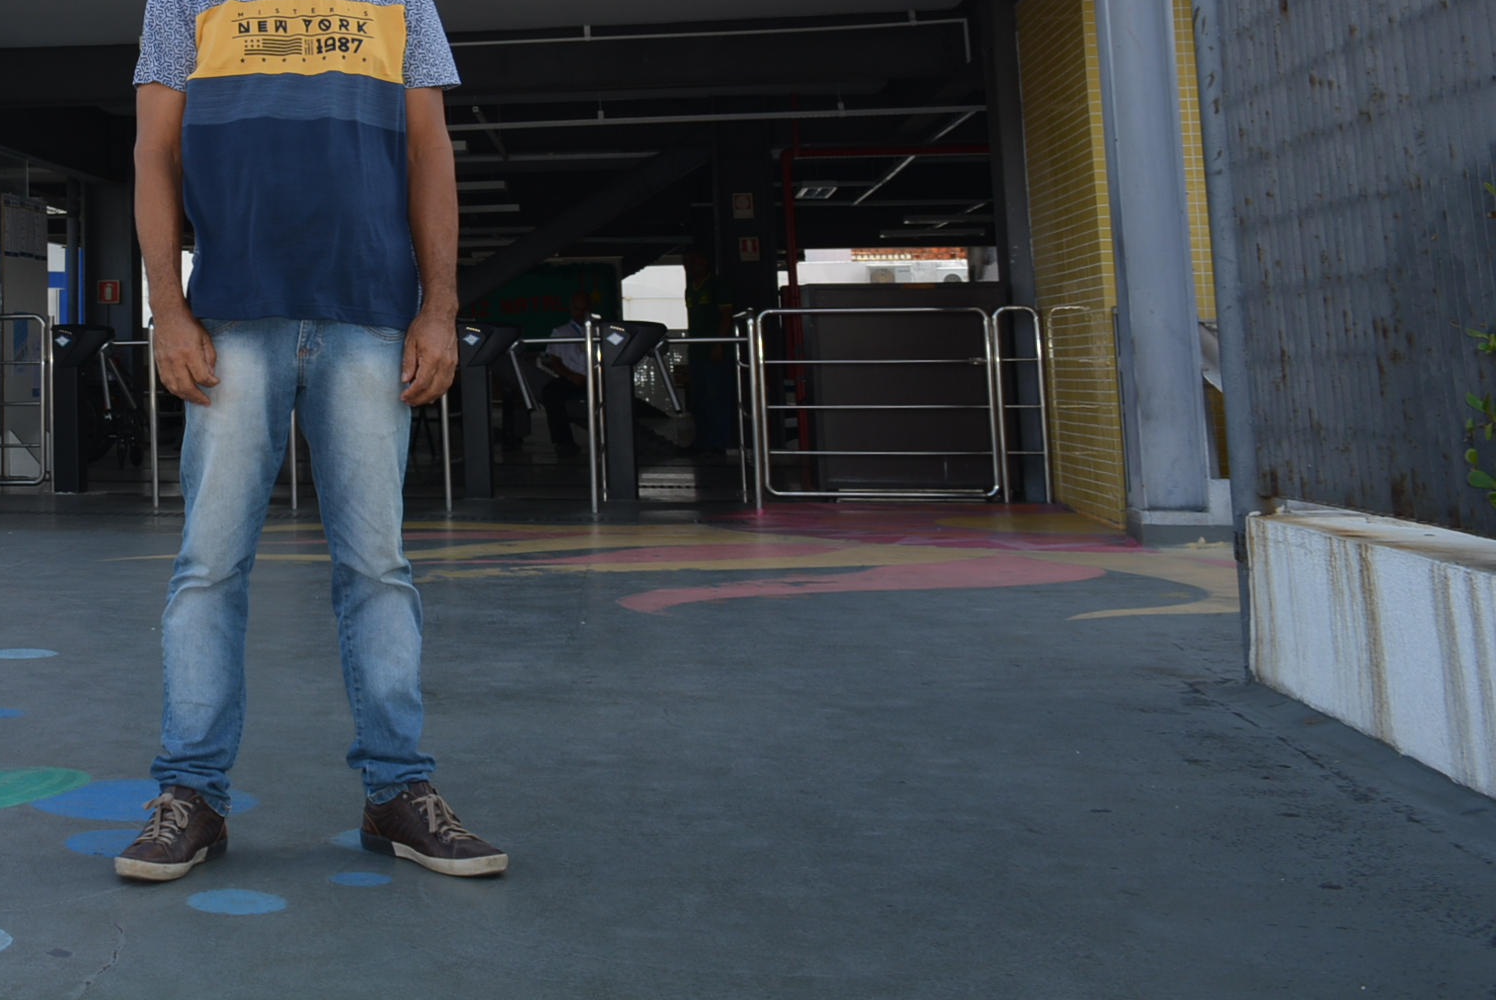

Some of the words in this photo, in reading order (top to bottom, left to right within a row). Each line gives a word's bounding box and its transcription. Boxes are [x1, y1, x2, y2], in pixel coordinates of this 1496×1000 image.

[238, 19, 287, 34] NEW
[301, 18, 367, 34] YORK
[316, 36, 364, 54] 1987
[500, 294, 568, 315] NATAL
